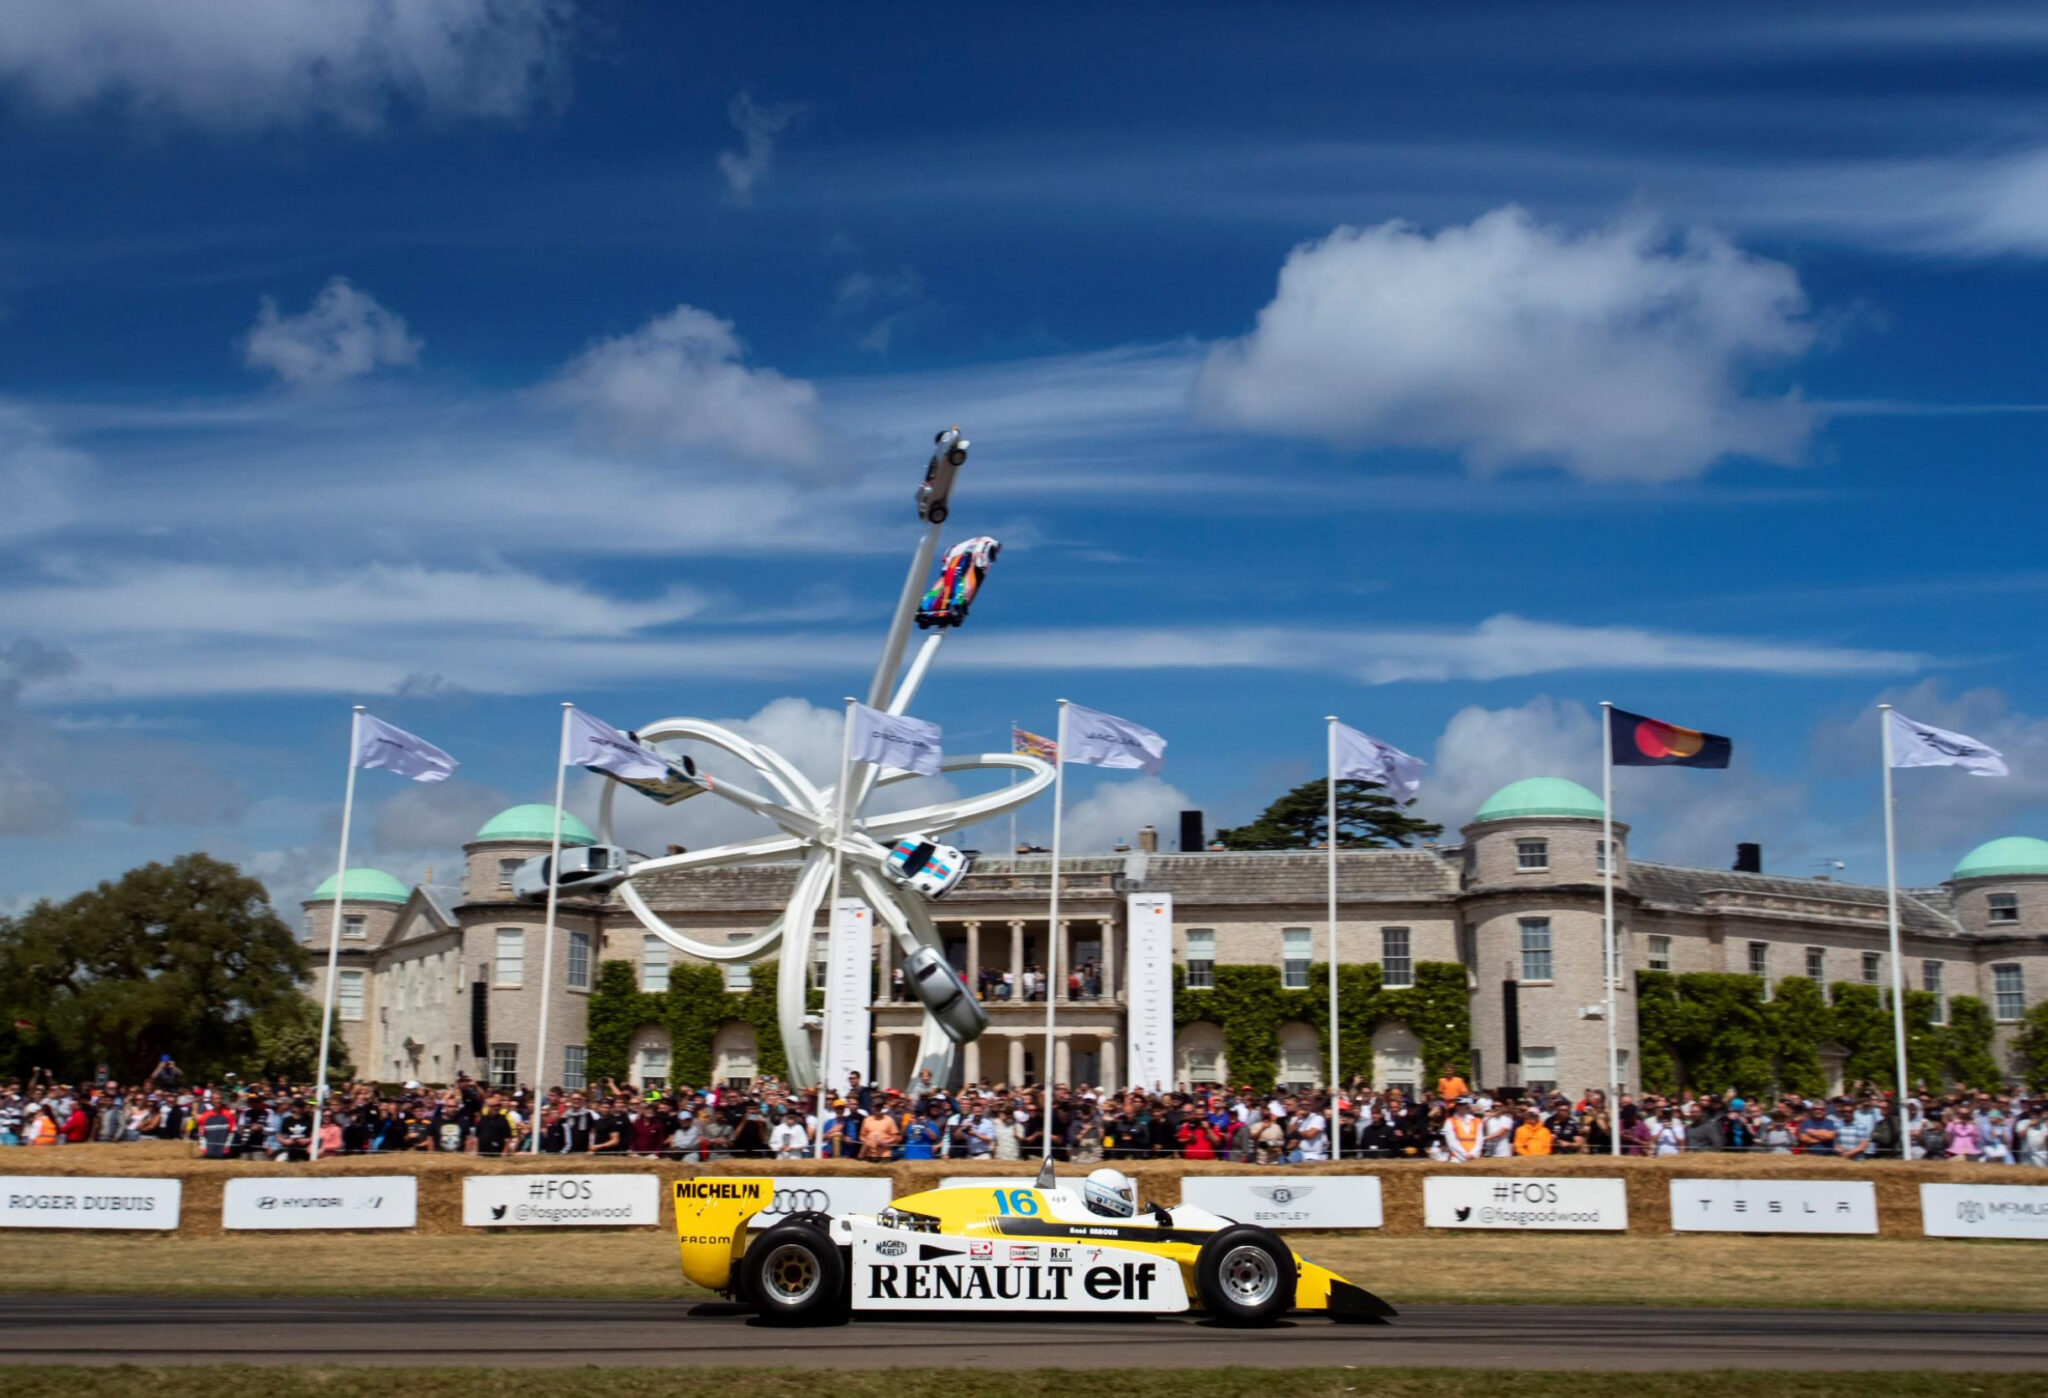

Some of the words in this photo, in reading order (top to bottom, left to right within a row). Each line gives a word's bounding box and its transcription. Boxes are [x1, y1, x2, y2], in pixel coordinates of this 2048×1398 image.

[529, 1180, 592, 1200] #FOS
[676, 1183, 759, 1199] MICHELIN
[1493, 1183, 1558, 1203] #FOS
[9, 1194, 76, 1209] ROGER
[83, 1196, 155, 1211] DUBUIS
[282, 1198, 343, 1208] HYUNDAI
[993, 1189, 1038, 1216] 16
[1700, 1200, 1850, 1213] TESLA
[514, 1204, 632, 1221] @fosgoodwood
[1255, 1212, 1310, 1220] BENTLEY
[1480, 1206, 1599, 1225] @fosgoodwood
[868, 1264, 1073, 1299] RENAULT
[1083, 1263, 1156, 1301] elf
